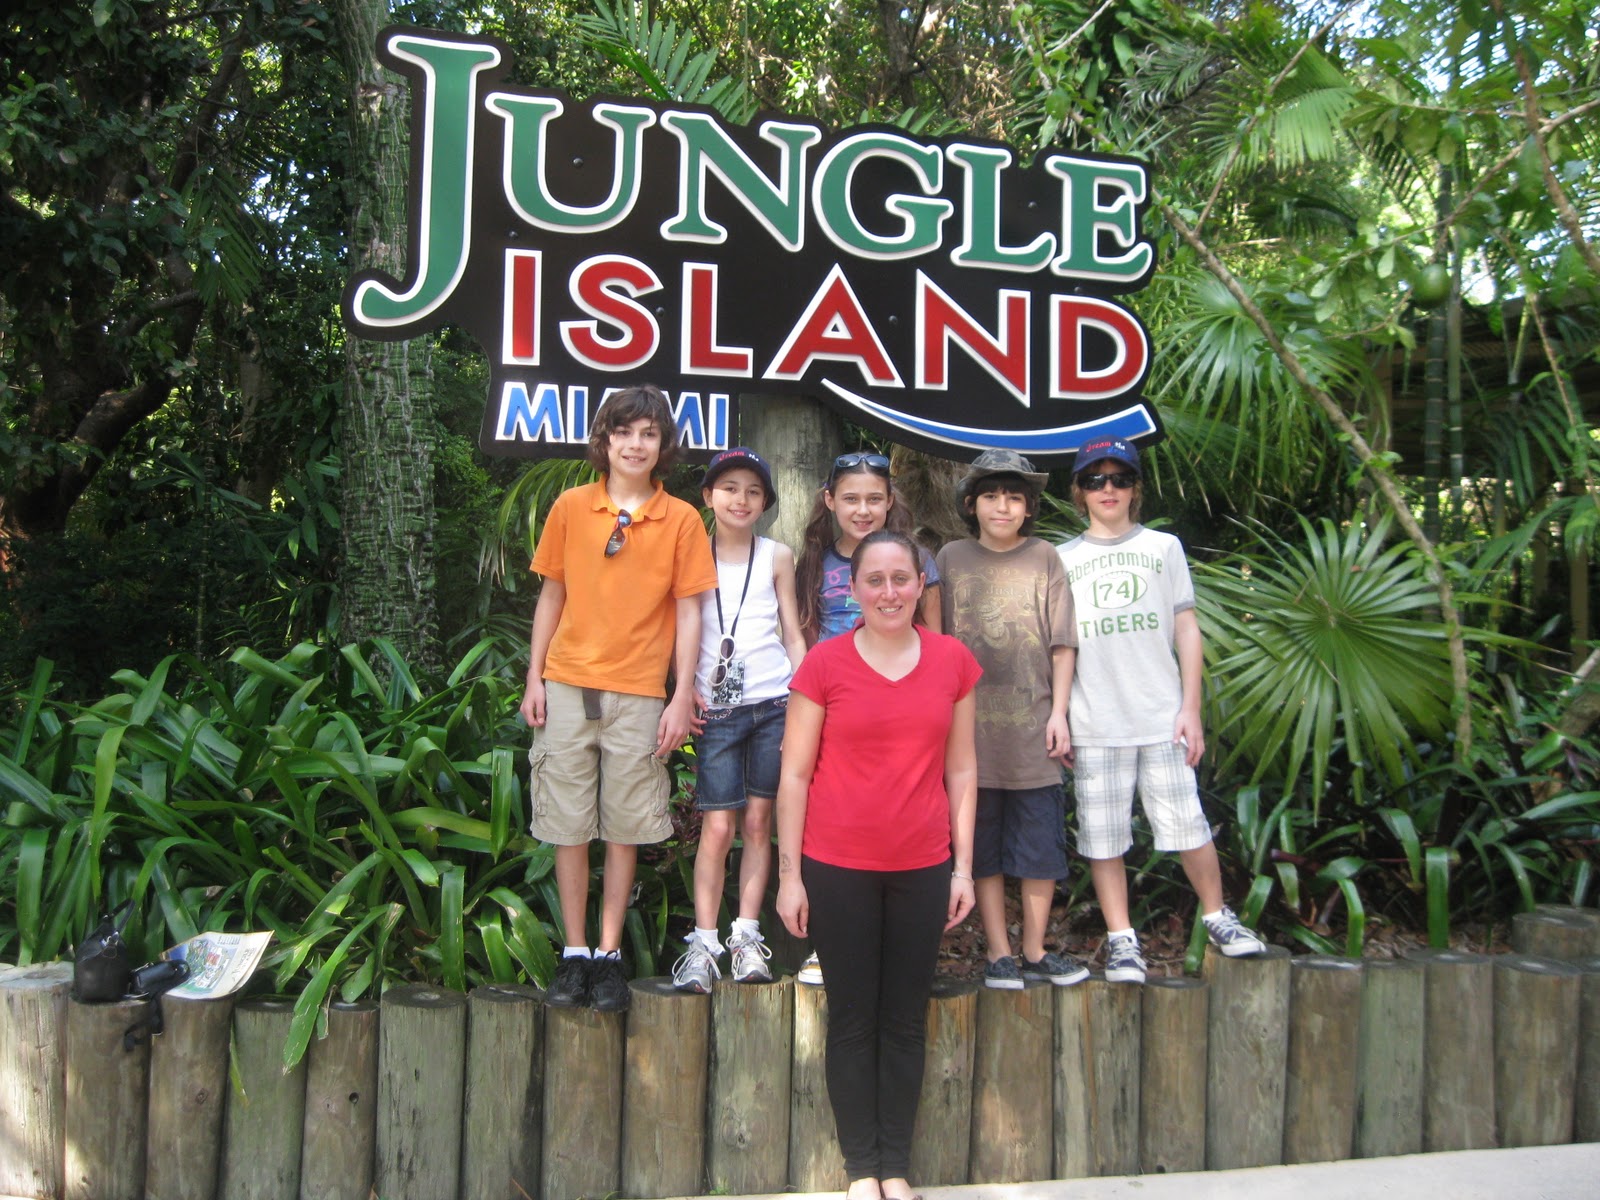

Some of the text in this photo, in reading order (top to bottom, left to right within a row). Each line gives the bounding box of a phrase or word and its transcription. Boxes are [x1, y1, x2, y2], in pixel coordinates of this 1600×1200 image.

[353, 35, 1153, 327] JUNGLE
[502, 248, 1148, 407] ISLAND
[495, 381, 729, 450] MIMI
[1067, 552, 1162, 584] abercrombie
[1099, 580, 1130, 601] 74
[1080, 612, 1159, 638] TIGERS
